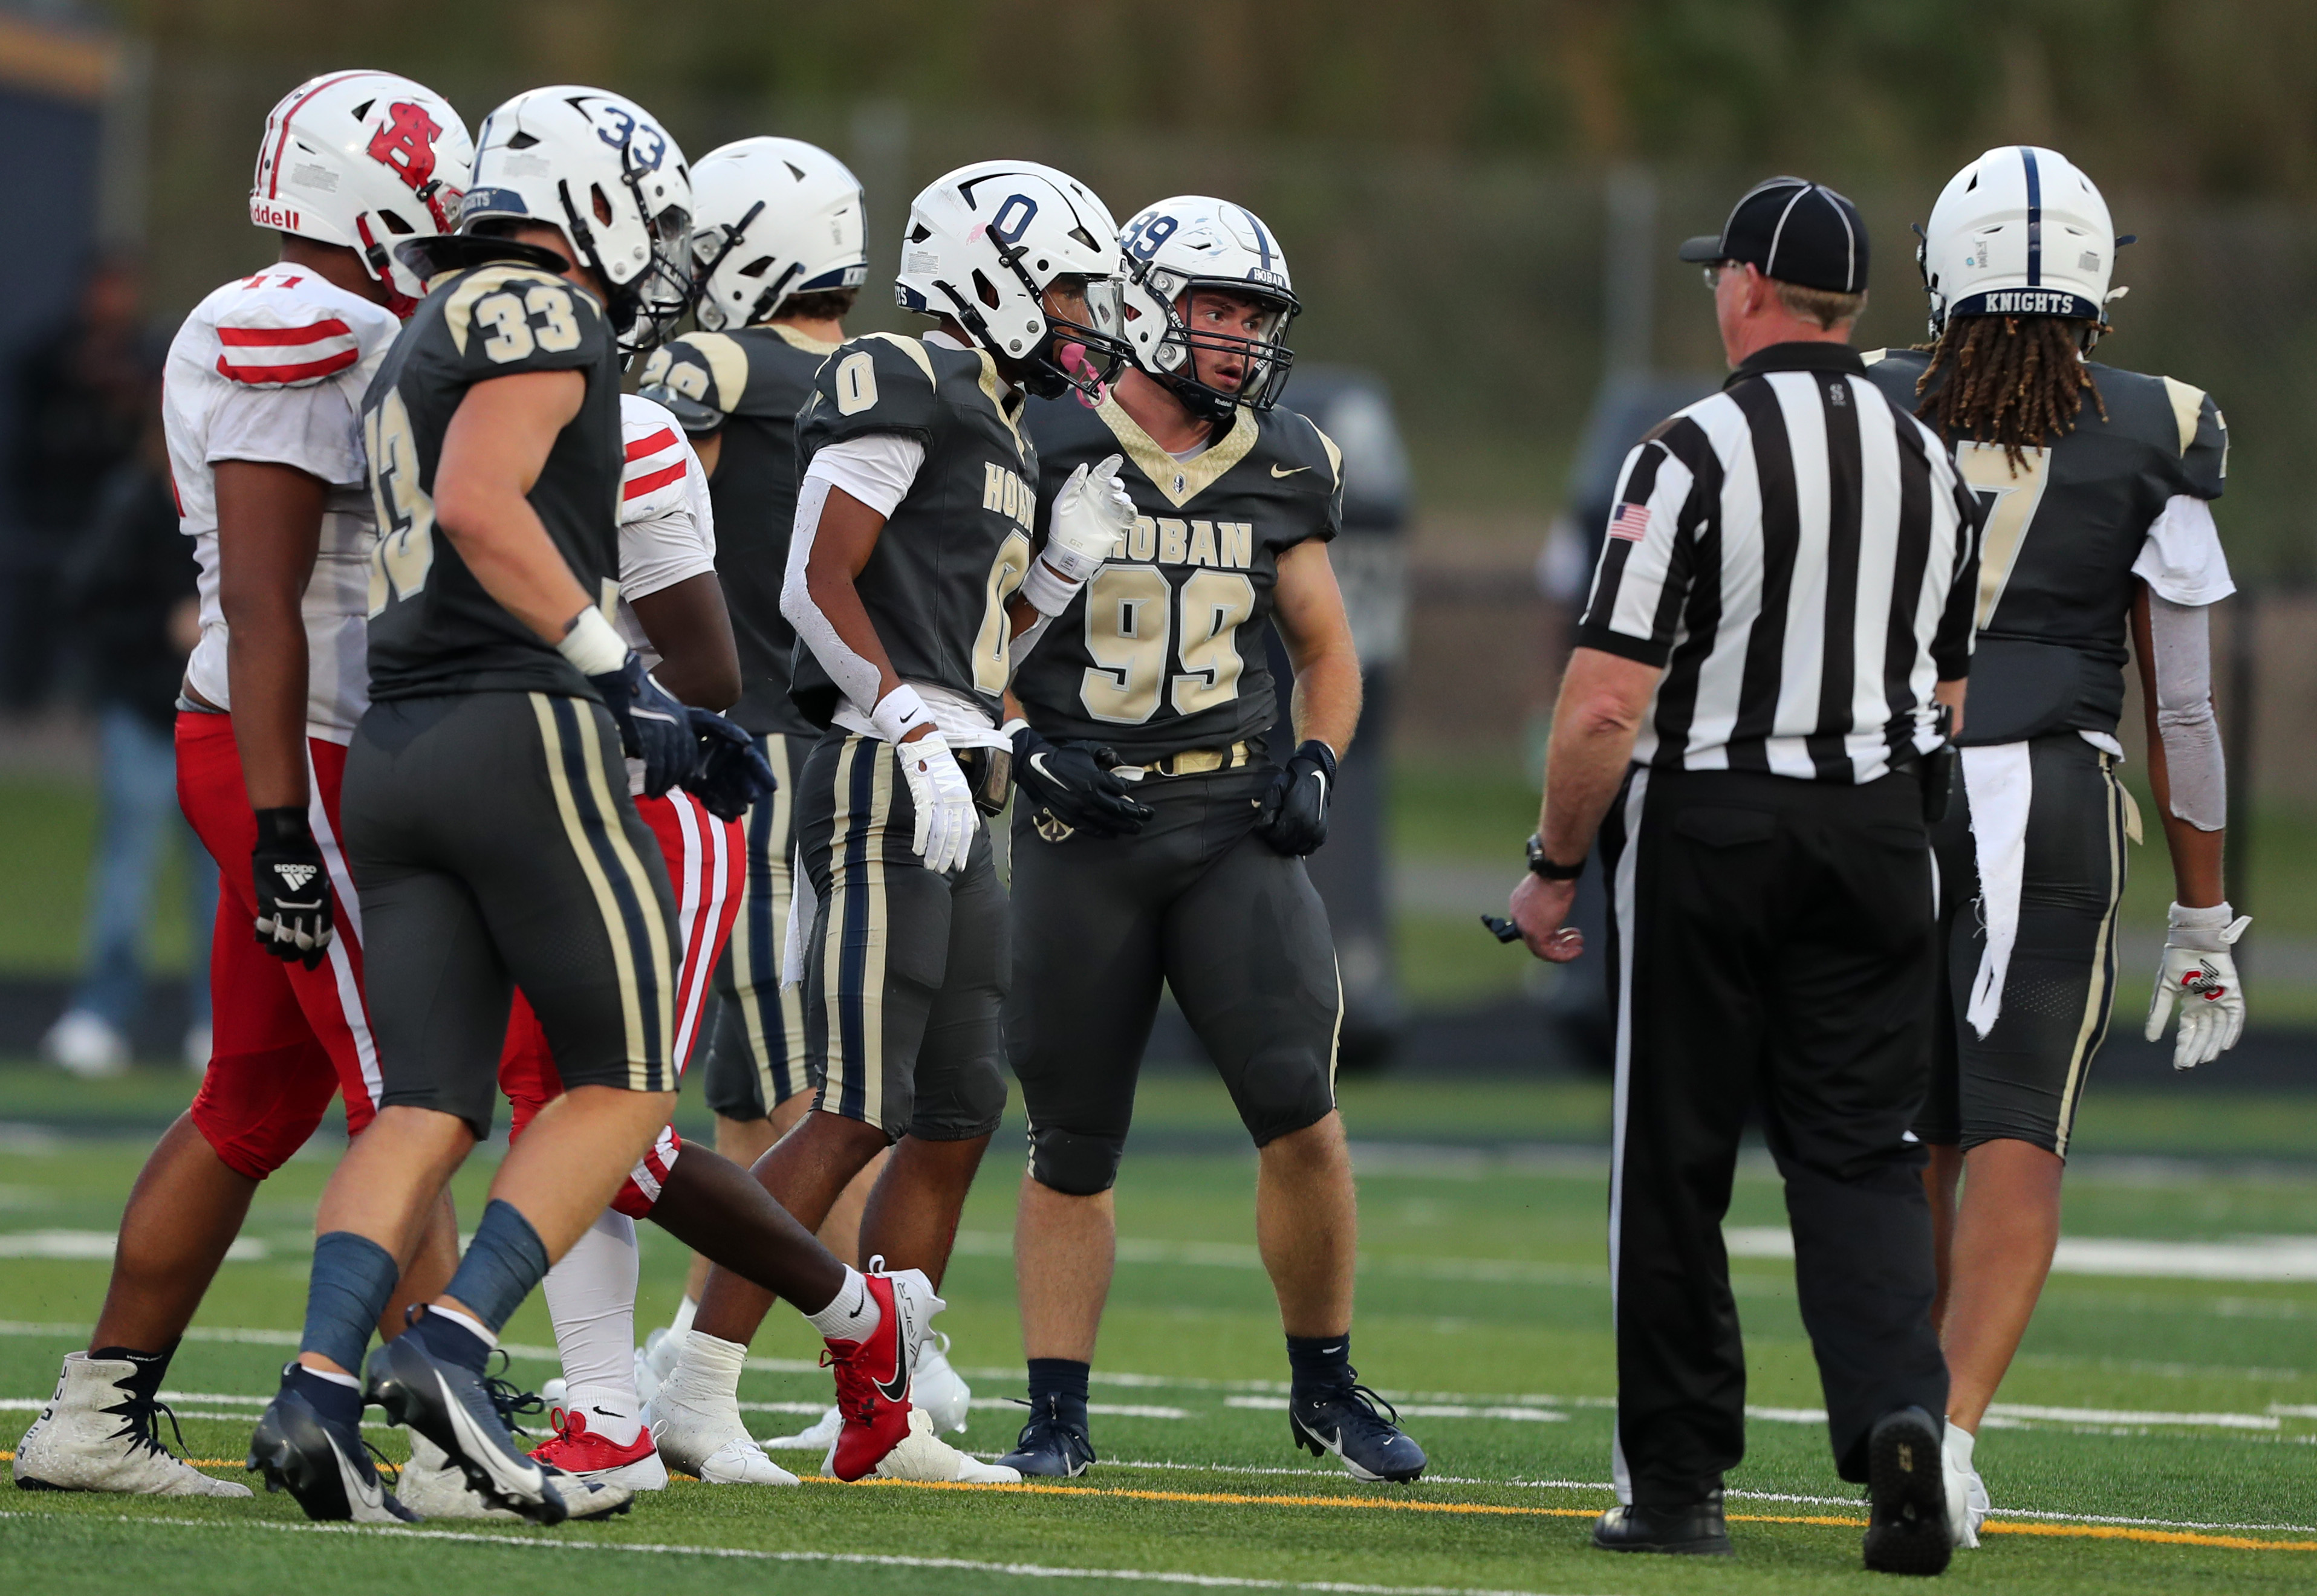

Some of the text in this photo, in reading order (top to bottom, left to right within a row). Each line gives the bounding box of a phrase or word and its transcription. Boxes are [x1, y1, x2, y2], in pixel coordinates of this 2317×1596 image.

[597, 107, 666, 172] 33
[250, 204, 300, 231] ddell
[992, 193, 1038, 244] 0
[1119, 210, 1178, 262] 99
[1253, 268, 1283, 287] HOBAN
[1985, 292, 2075, 314] KNIGHTS
[475, 285, 582, 365] 33
[836, 351, 879, 417] 0
[1954, 440, 2052, 631] 7
[971, 528, 1030, 698] 0
[1079, 563, 1256, 725] 99
